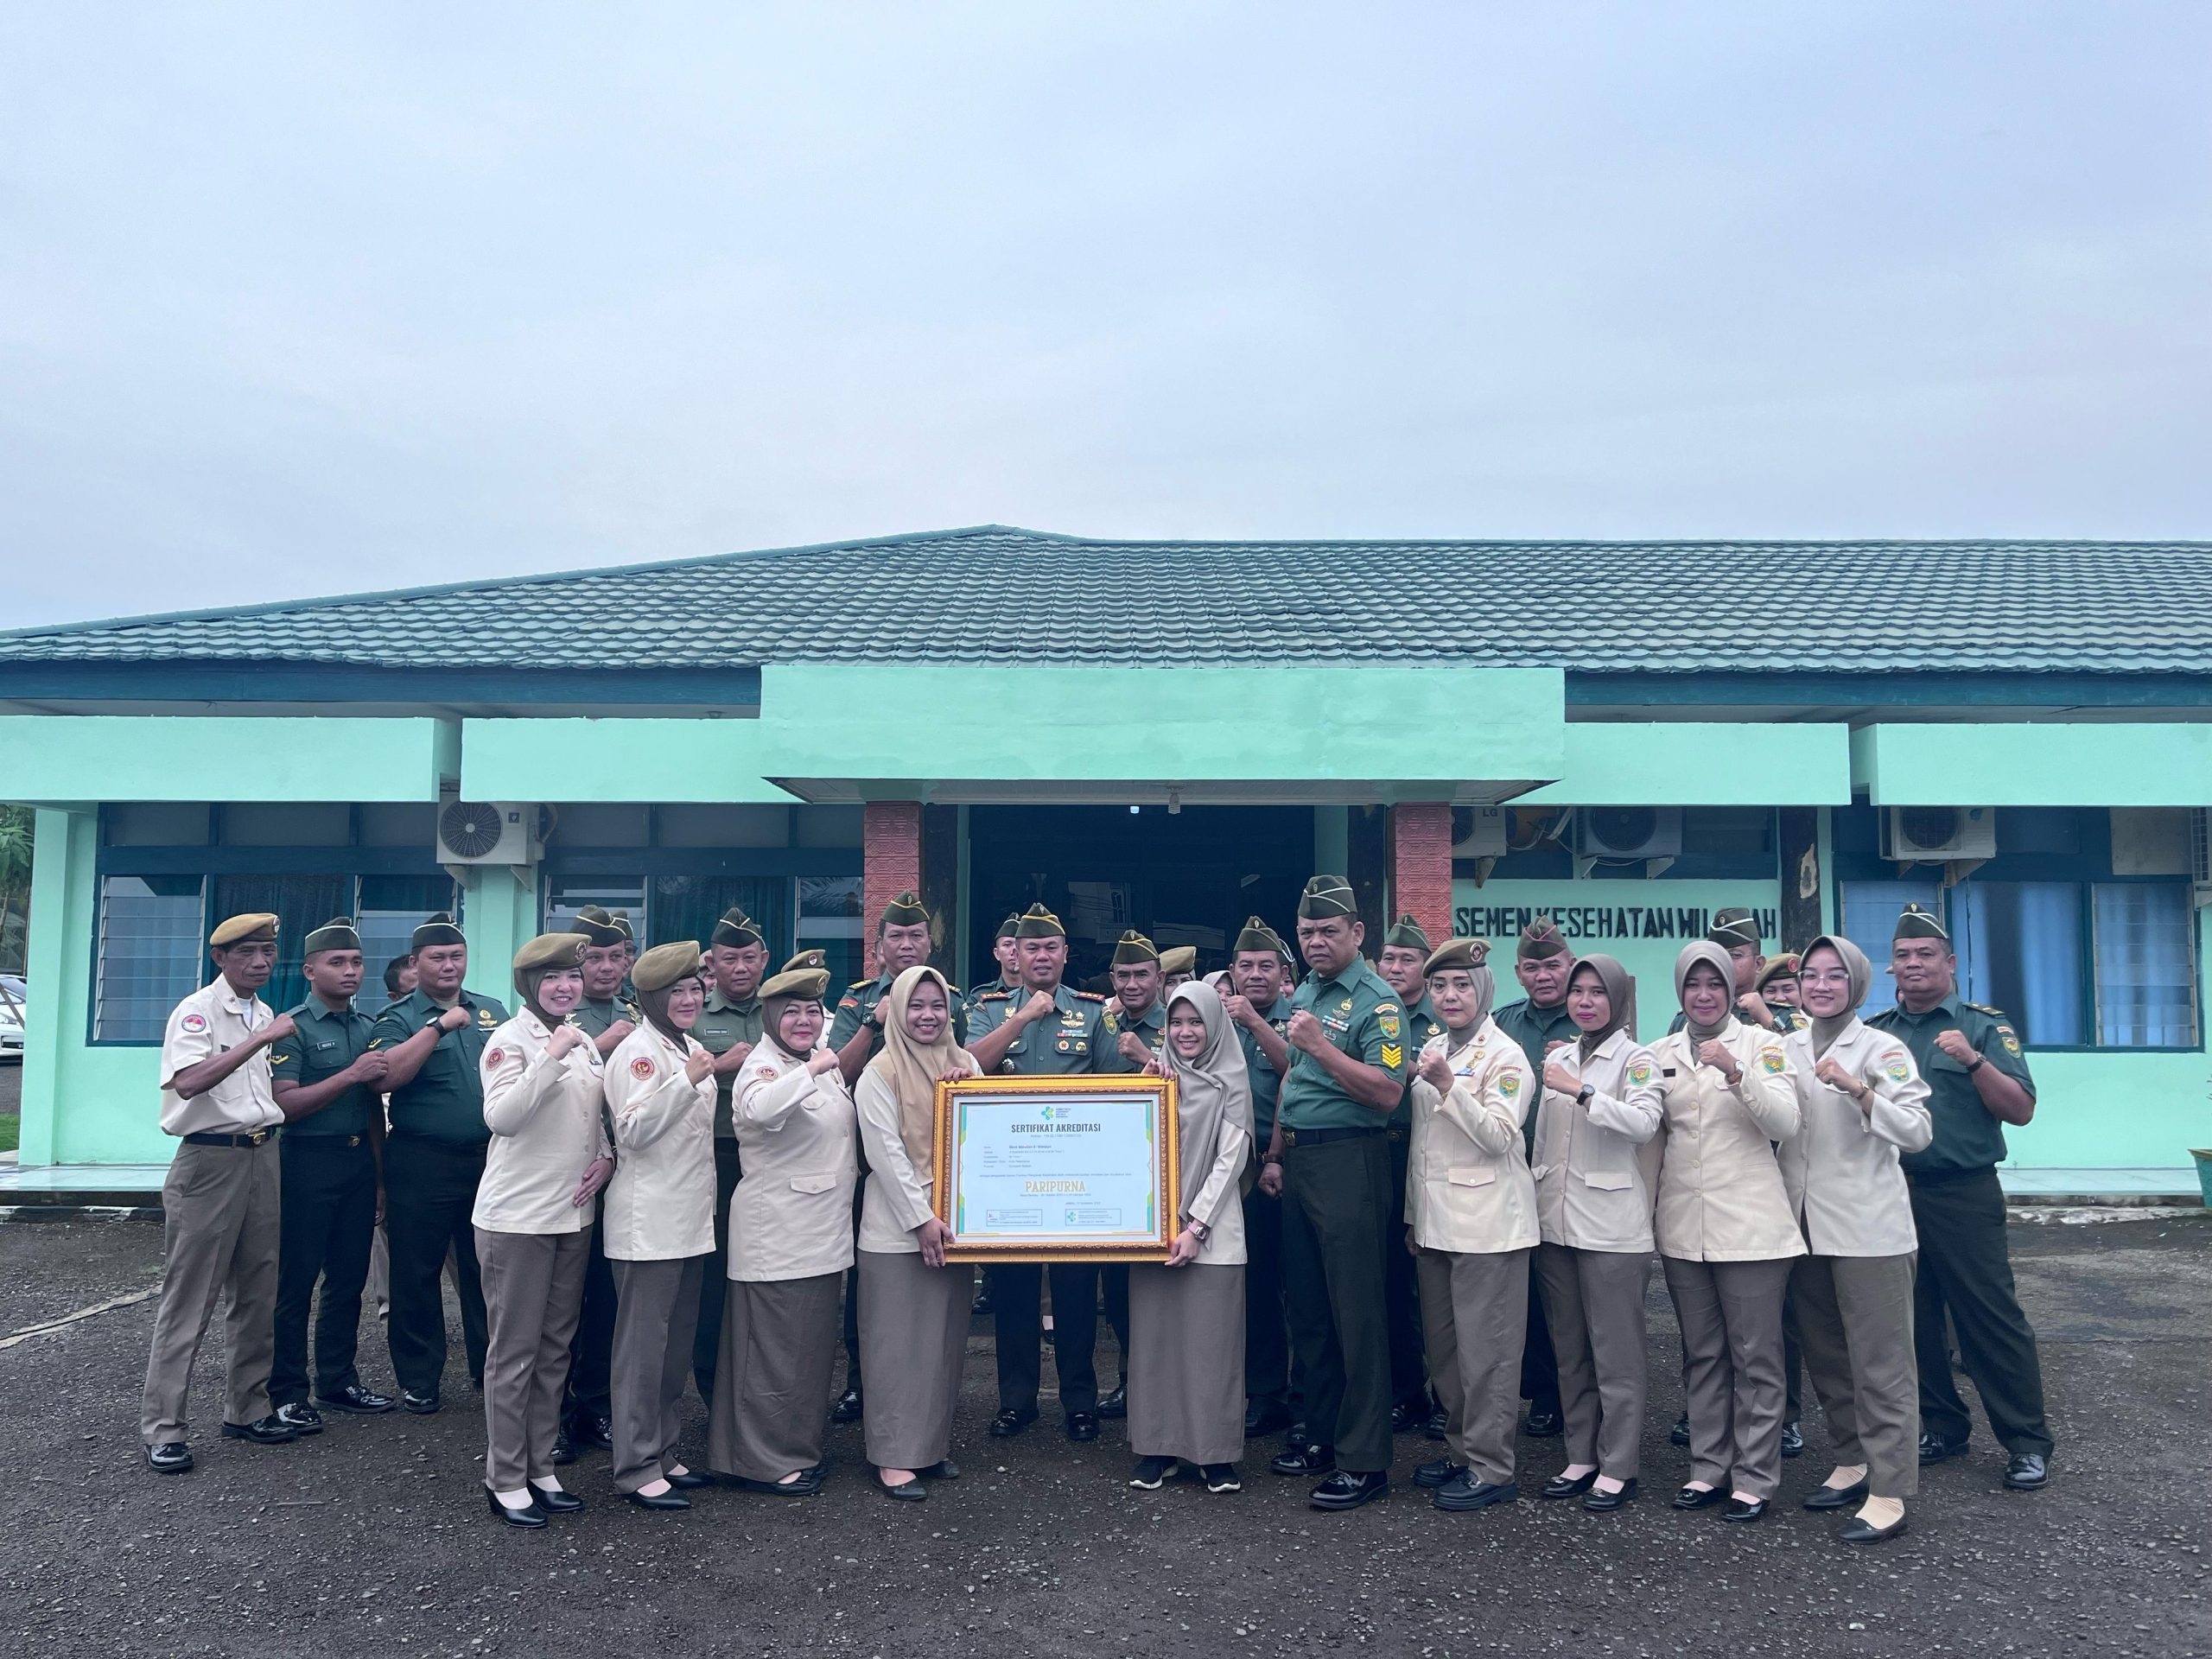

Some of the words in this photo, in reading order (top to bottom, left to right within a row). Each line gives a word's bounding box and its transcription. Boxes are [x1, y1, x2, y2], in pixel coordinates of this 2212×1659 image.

[1482, 808, 1498, 817] LG
[1011, 1124, 1053, 1133] SERTIFIKAT
[1056, 1123, 1101, 1133] AKREDITASI
[1025, 1180, 1086, 1192] PARIPURNA
